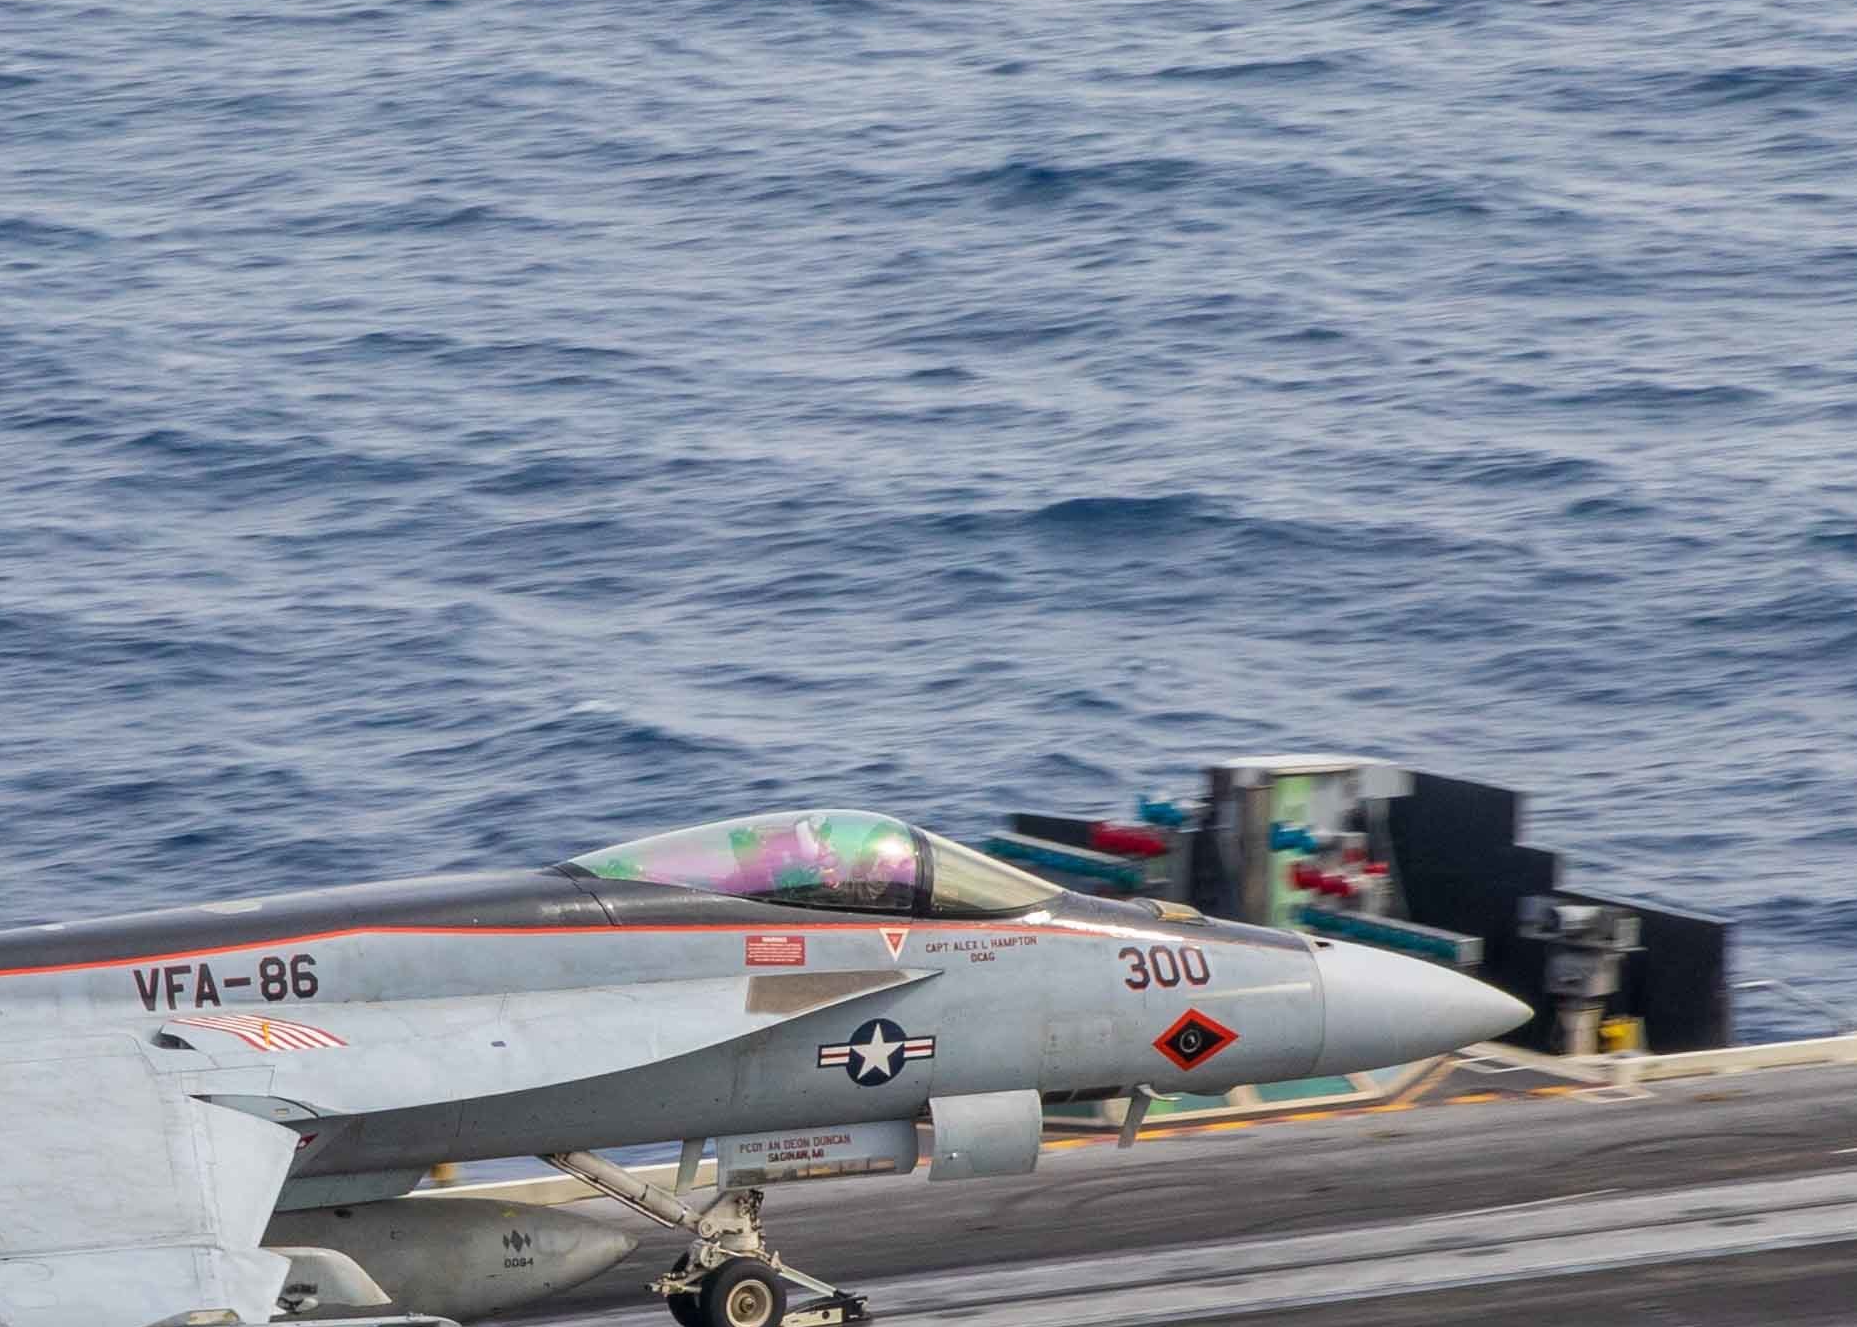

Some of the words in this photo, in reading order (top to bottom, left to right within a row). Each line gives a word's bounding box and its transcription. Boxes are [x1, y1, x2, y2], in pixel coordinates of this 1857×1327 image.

[925, 943, 949, 954] CAPT
[990, 936, 1039, 948] HAMPTON
[132, 953, 319, 1012] VFA-86
[1118, 944, 1212, 991] 300
[813, 1133, 852, 1147] DUNCAN
